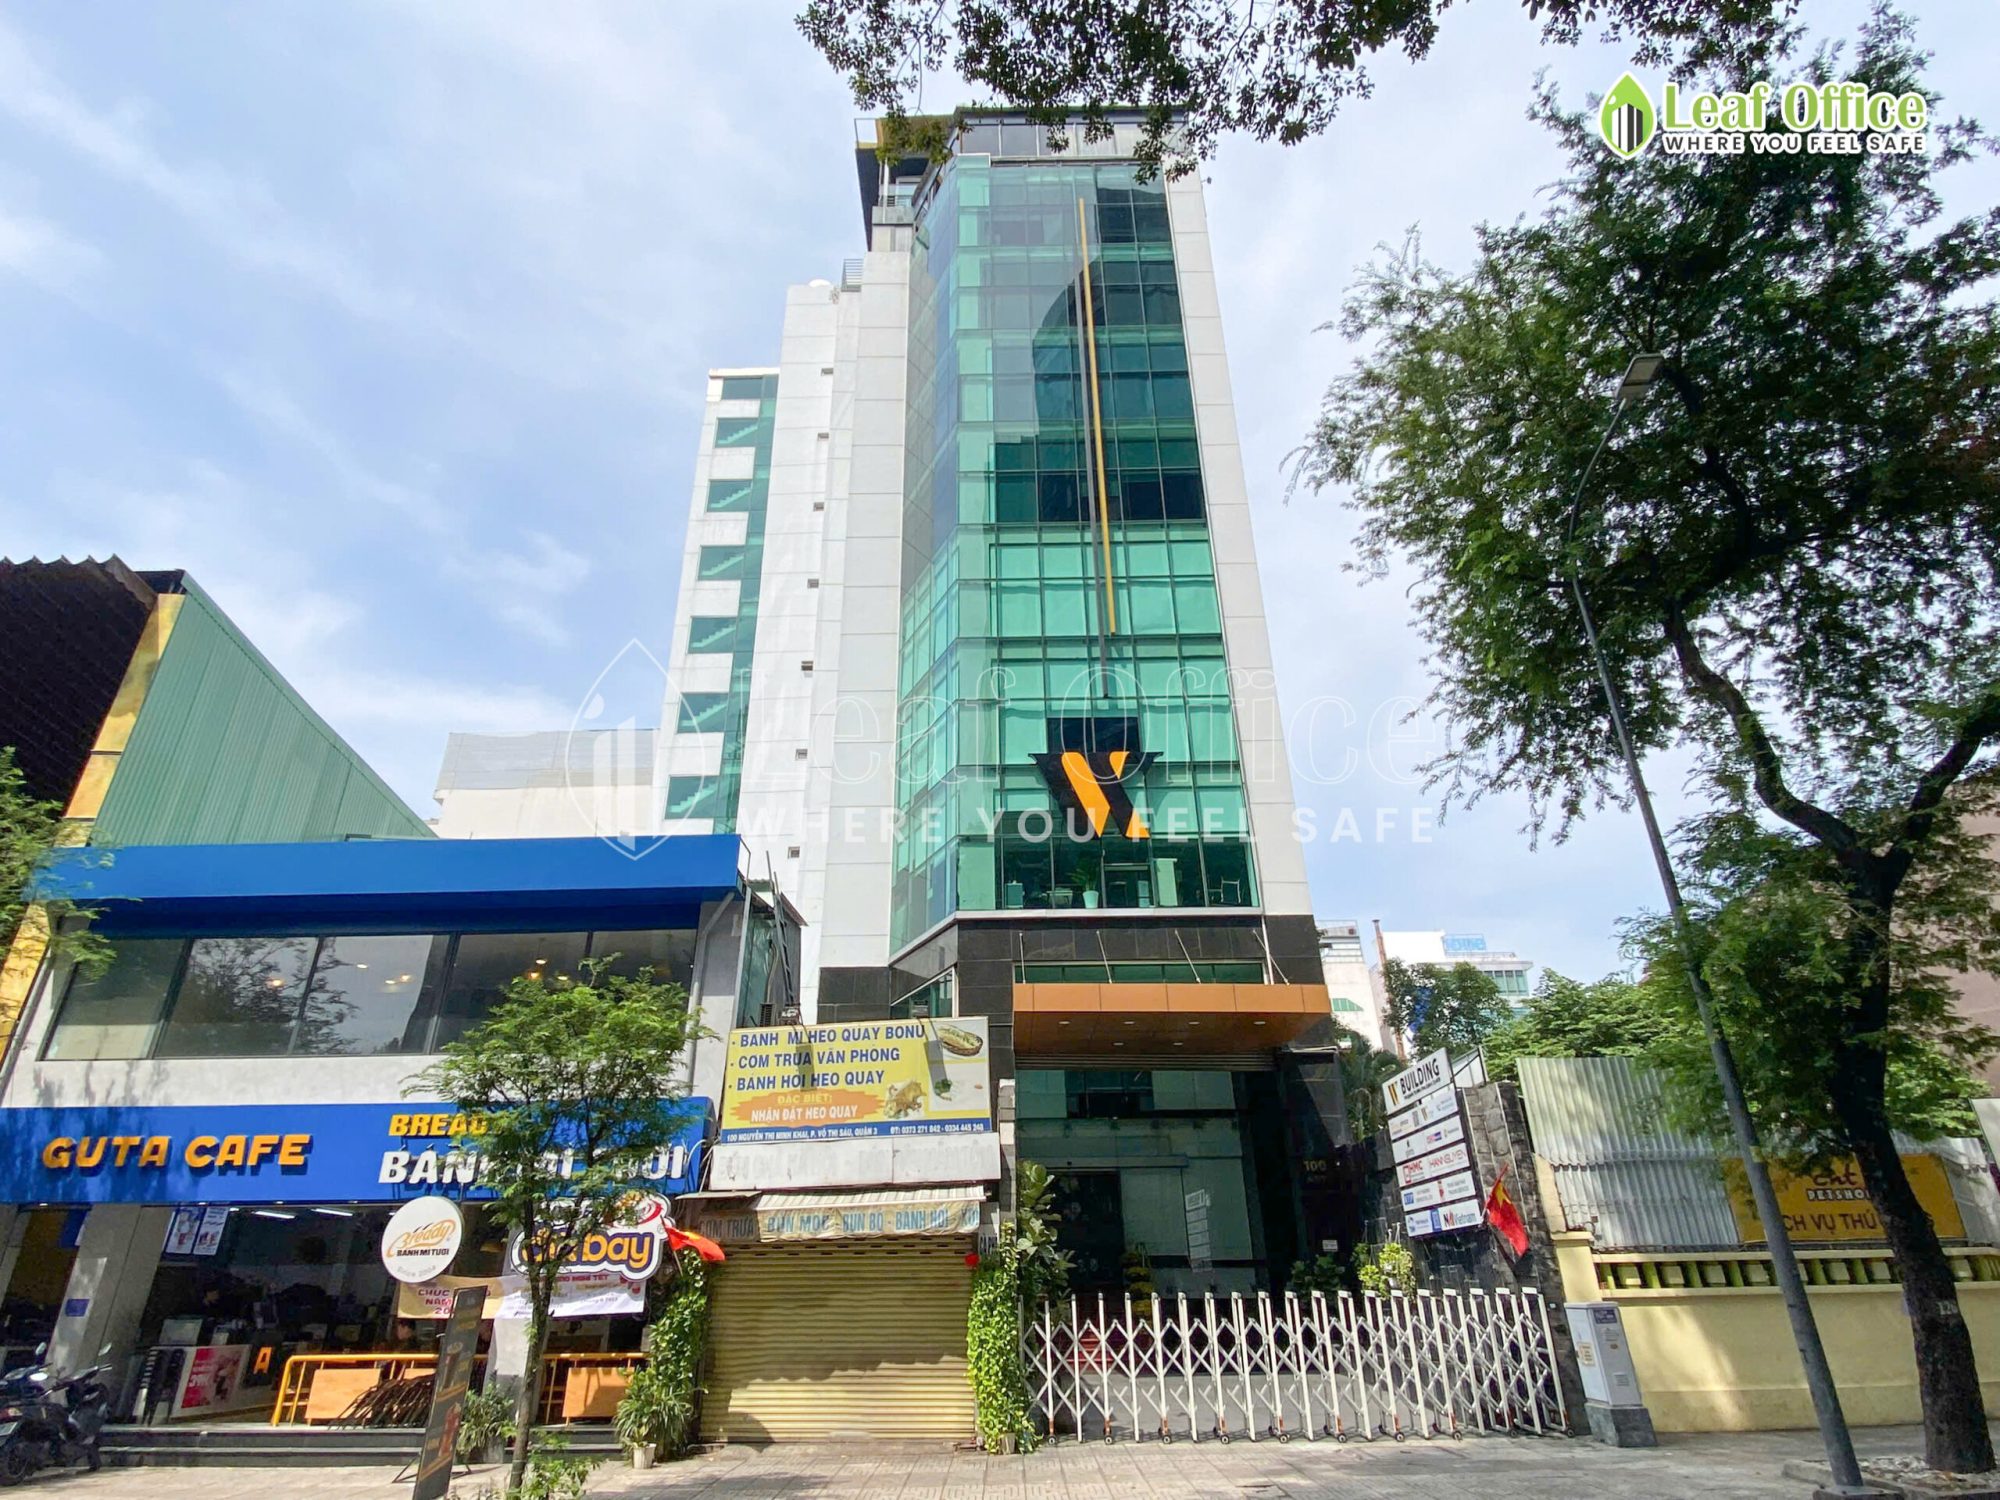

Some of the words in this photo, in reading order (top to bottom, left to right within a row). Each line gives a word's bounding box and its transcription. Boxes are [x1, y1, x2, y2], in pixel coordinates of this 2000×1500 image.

[809, 1028, 837, 1044] HEO
[841, 1026, 880, 1042] QUAY
[810, 1071, 839, 1088] HEO
[844, 1069, 885, 1085] QUAY
[1400, 1058, 1440, 1094] BUILDING
[806, 1107, 826, 1119] HEO
[829, 1105, 858, 1118] QUAY
[42, 1136, 171, 1168] GUTA
[184, 1134, 311, 1166] CAFE
[1810, 1213, 1836, 1234] VỤ
[1838, 1208, 1876, 1230] THÚ
